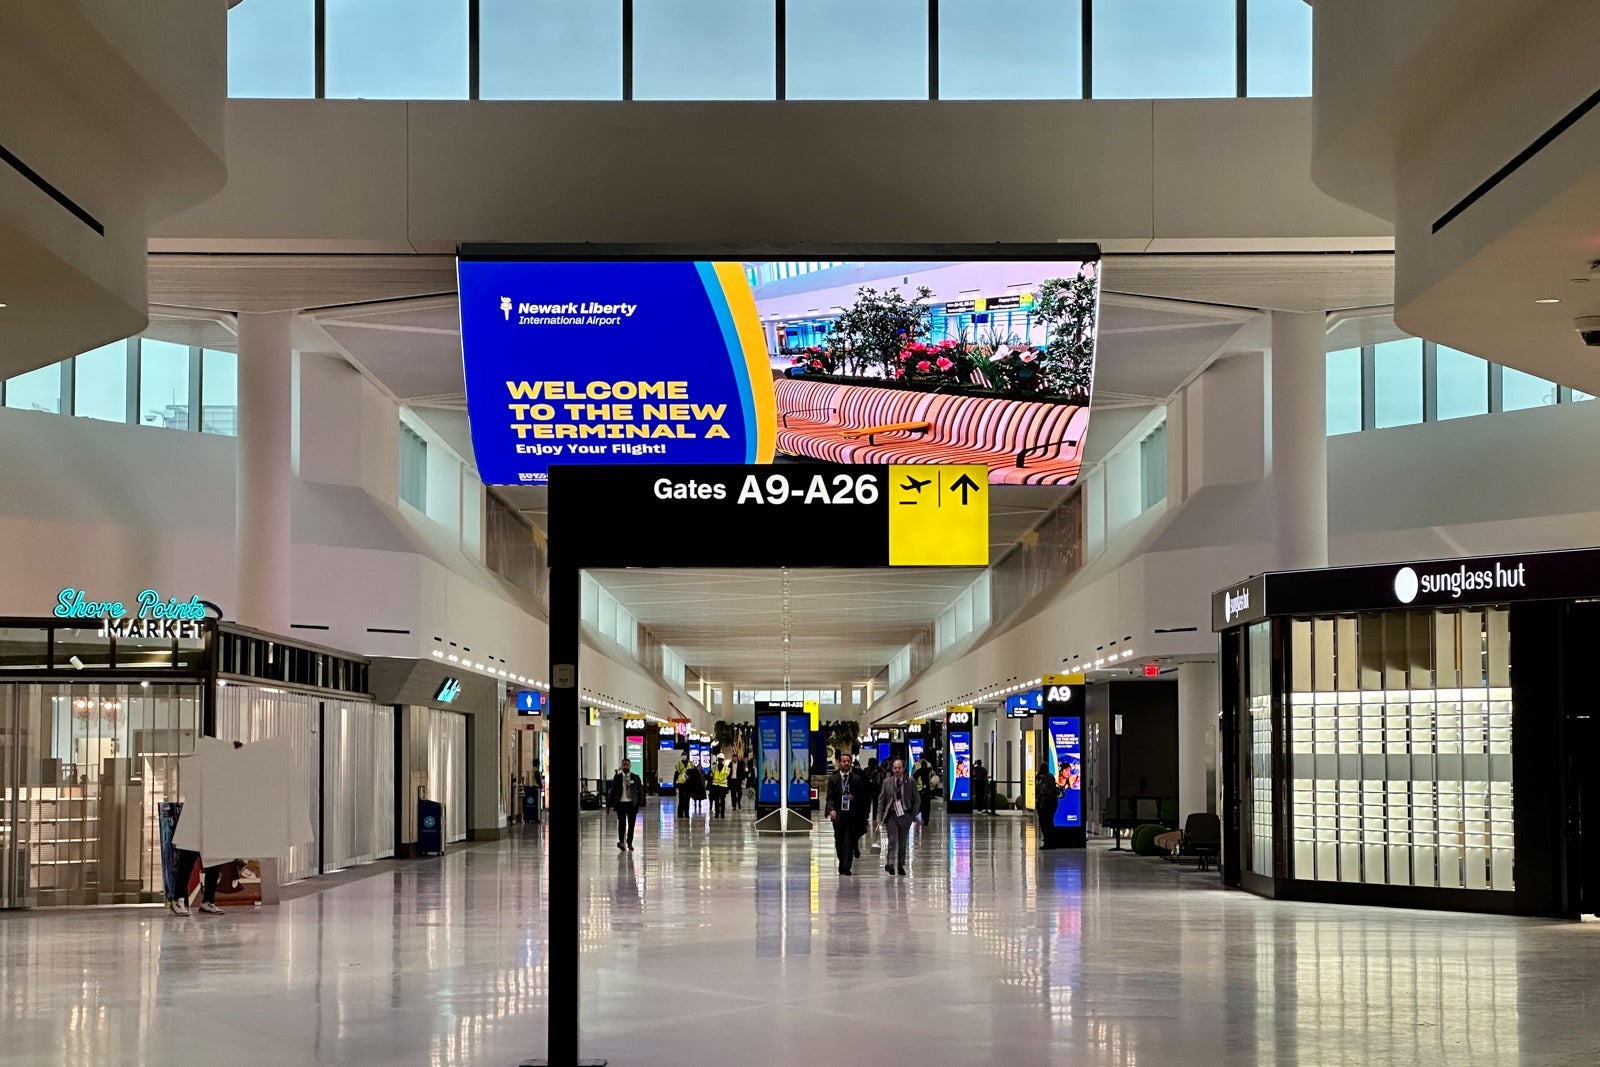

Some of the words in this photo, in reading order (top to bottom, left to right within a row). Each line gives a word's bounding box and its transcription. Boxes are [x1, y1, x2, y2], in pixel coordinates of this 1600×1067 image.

[518, 302, 578, 314] Newark
[580, 302, 637, 317] Liberty
[518, 316, 585, 325] International
[586, 316, 621, 326] Airport
[506, 381, 689, 400] WELCOME
[508, 404, 555, 420] TO
[564, 404, 634, 420] THE
[643, 404, 728, 420] NEW
[510, 424, 696, 439] TERMINAL
[704, 424, 730, 438] A
[515, 443, 563, 456] Enjoy
[567, 444, 607, 454] Your
[612, 443, 666, 455] Flight!
[653, 478, 727, 499] Gates
[737, 474, 879, 504] A9-A26
[1421, 564, 1493, 598] sunglass
[1496, 562, 1526, 588] hut
[53, 588, 126, 618] Shore
[137, 589, 206, 619] Points
[103, 618, 205, 639] MARKET
[1047, 686, 1071, 701] A9
[949, 713, 969, 723] A10
